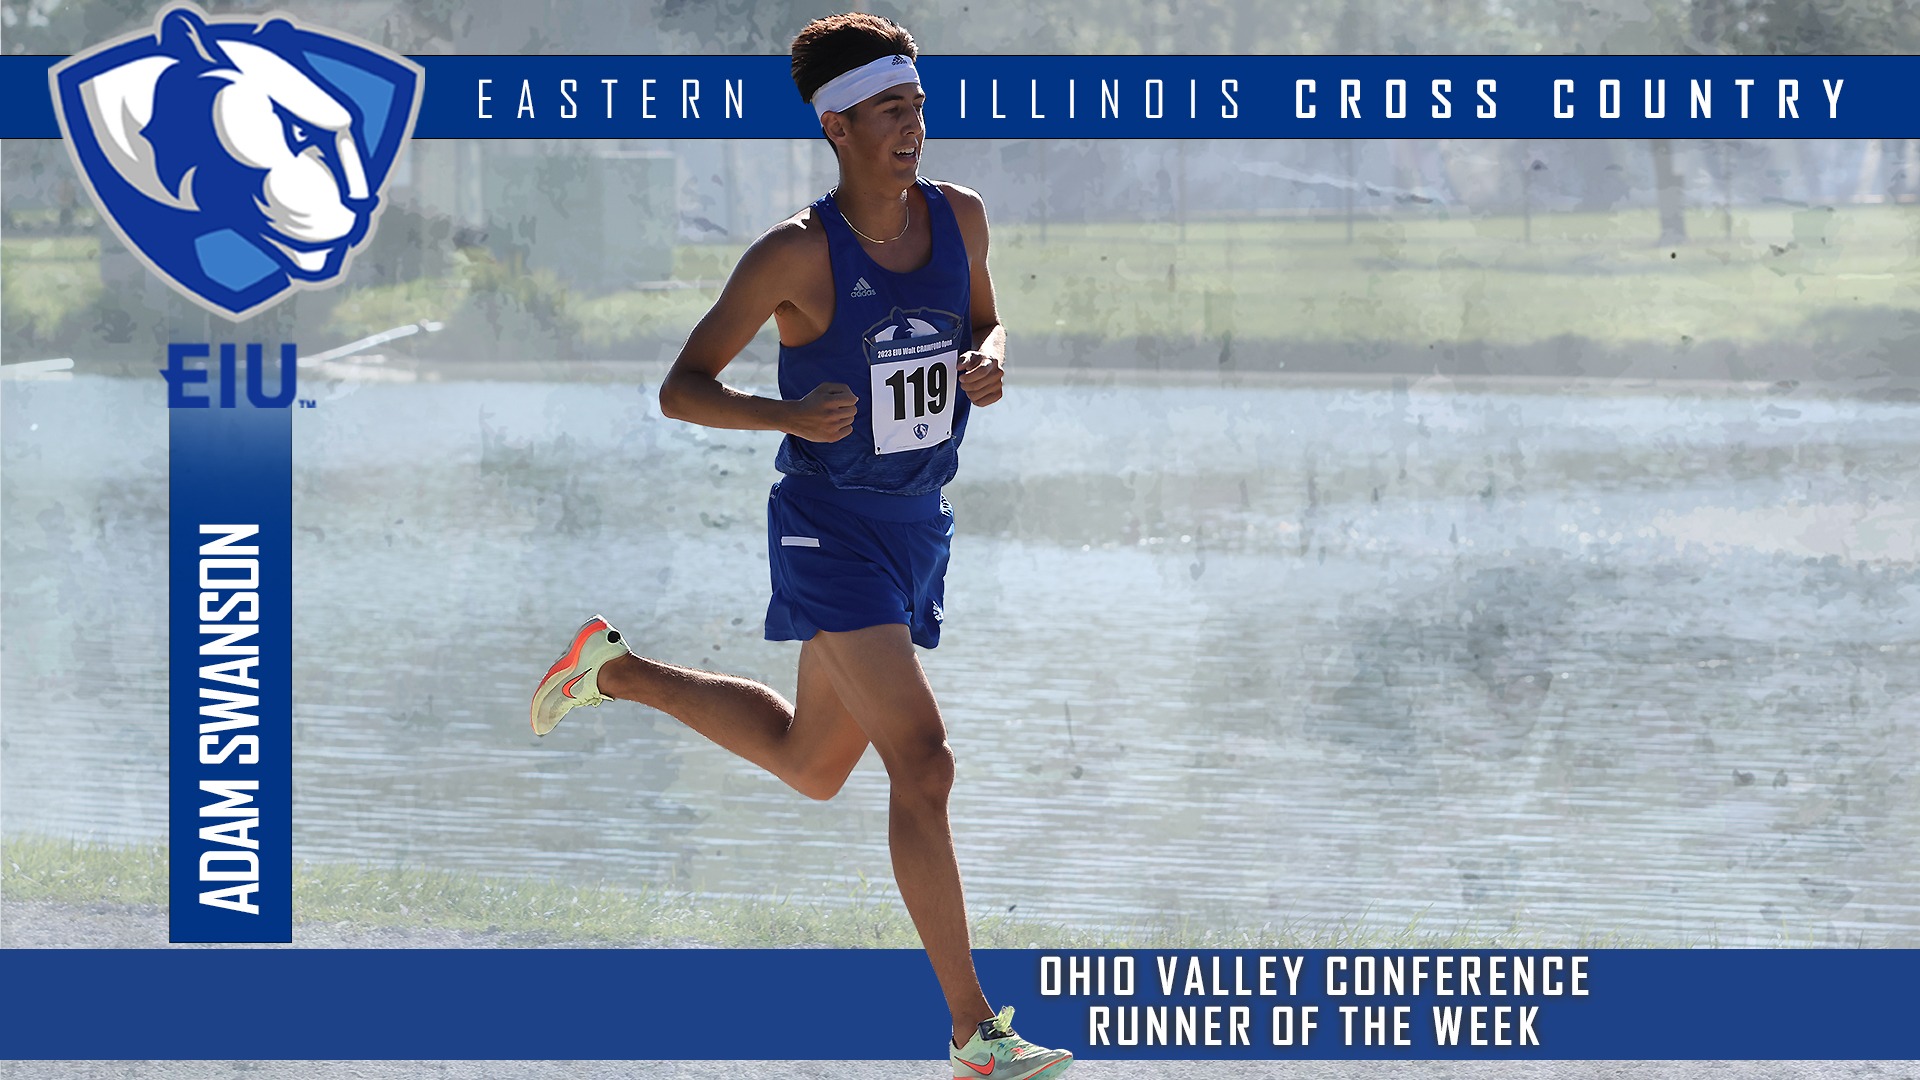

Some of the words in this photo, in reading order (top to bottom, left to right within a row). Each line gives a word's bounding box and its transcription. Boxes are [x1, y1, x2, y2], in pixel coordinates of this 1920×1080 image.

[877, 348, 892, 359] 2023
[892, 347, 902, 357] EIU
[902, 346, 916, 355] Walt
[885, 361, 948, 421] 119
